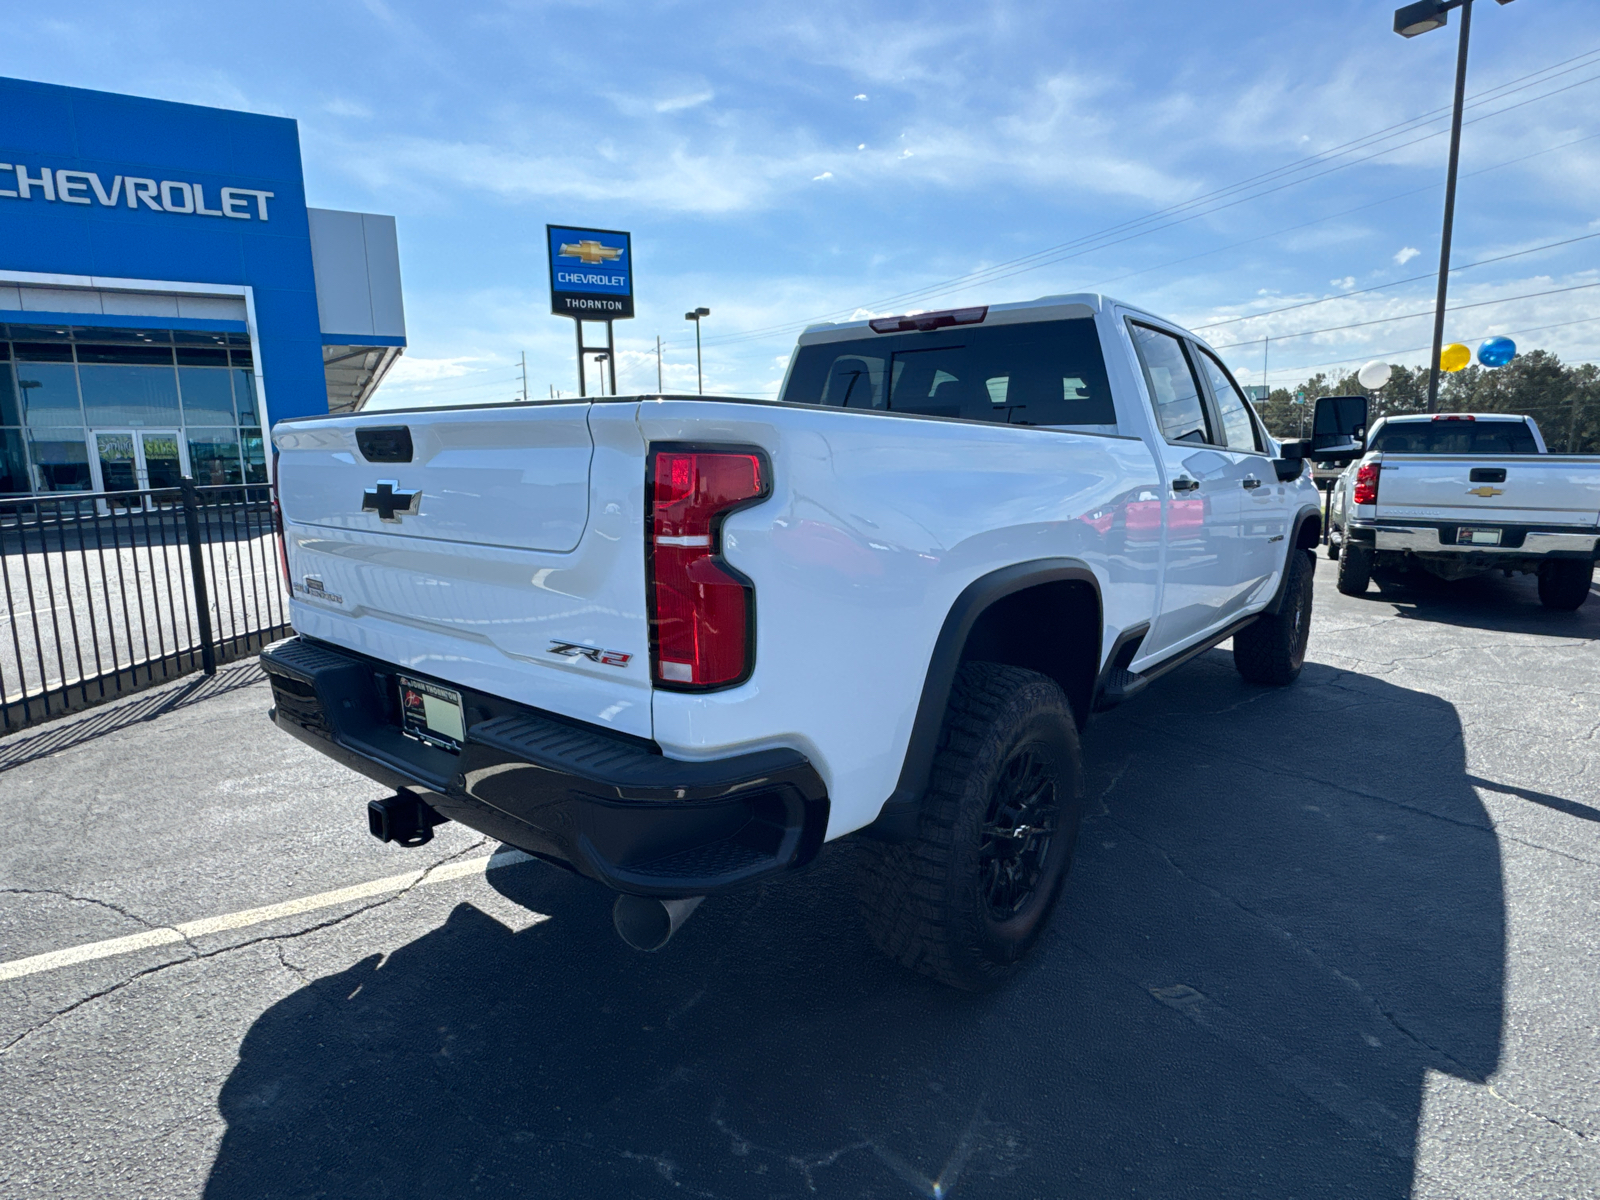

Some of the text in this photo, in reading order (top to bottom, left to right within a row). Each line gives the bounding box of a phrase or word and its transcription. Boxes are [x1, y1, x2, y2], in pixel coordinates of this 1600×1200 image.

[557, 272, 626, 286] CHEVROLET
[565, 298, 622, 310] THORNTON
[546, 639, 633, 668] ZR2
